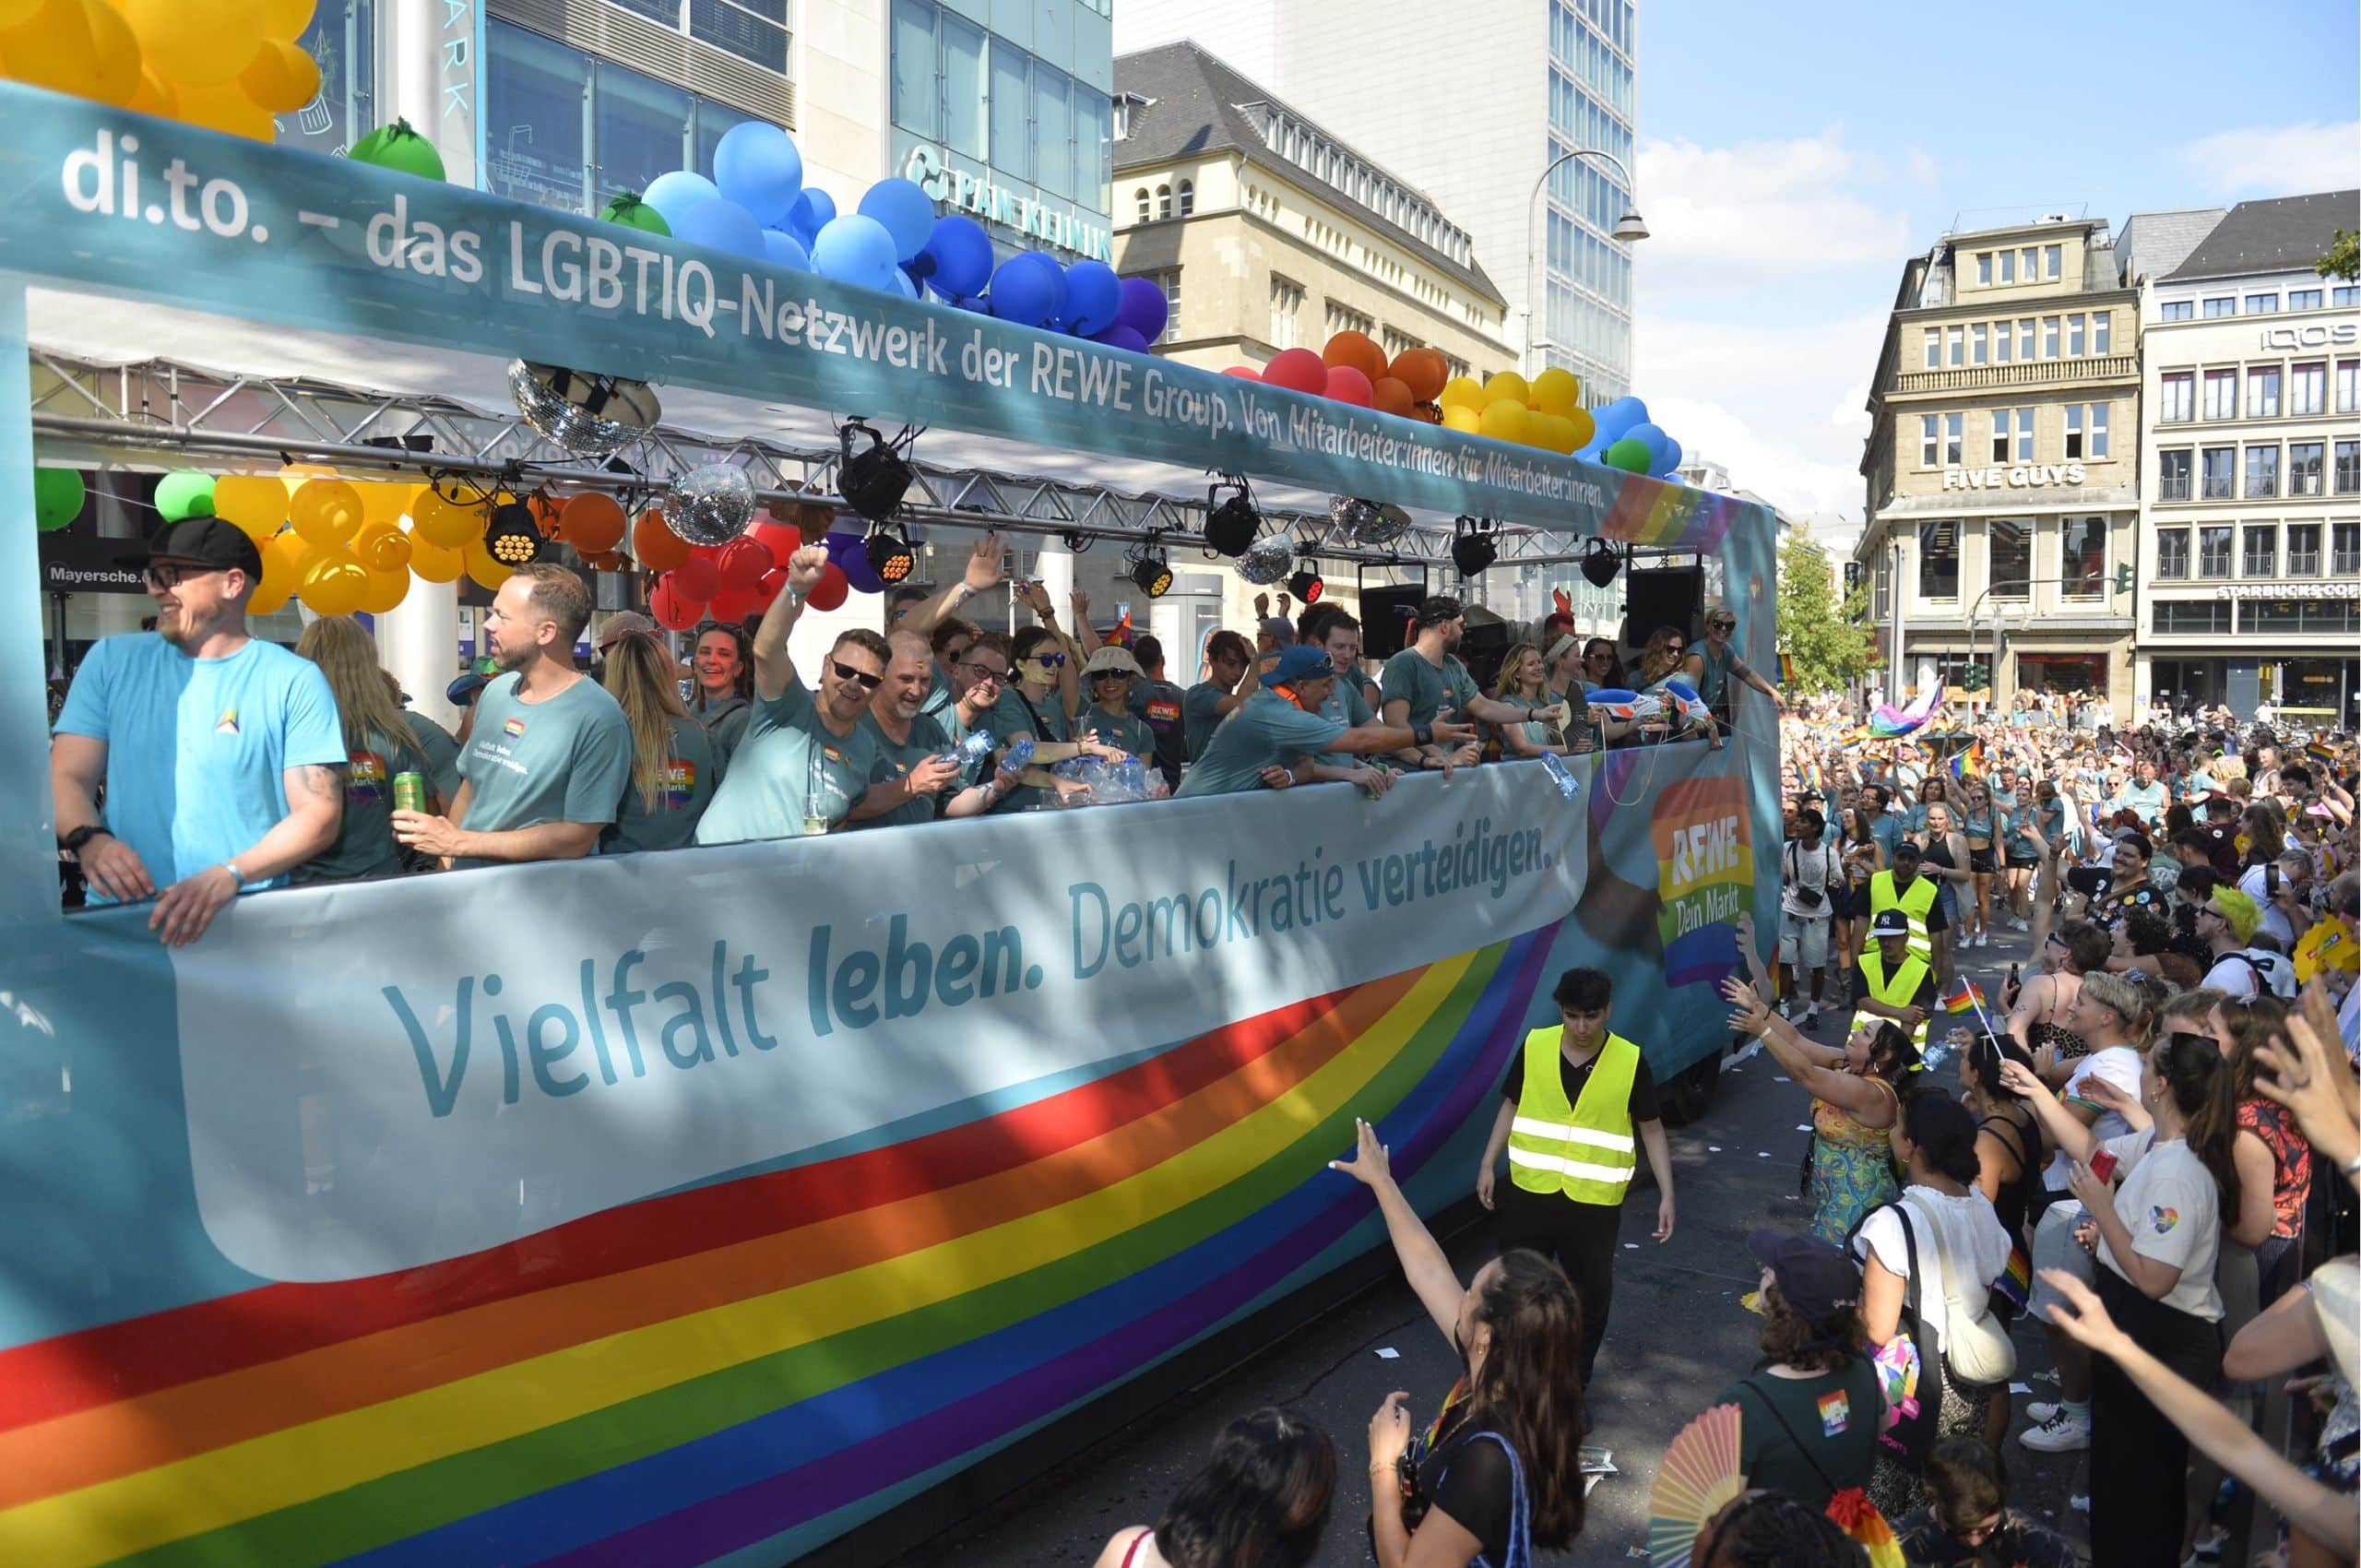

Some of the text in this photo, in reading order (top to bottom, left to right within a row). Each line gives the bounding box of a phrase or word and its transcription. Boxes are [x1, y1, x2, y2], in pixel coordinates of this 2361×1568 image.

[955, 169, 1112, 265] PAN KLINIK
[62, 128, 268, 244] di.to.
[367, 195, 483, 282] das
[510, 220, 947, 376] LGBTIQ-Netzwerk
[961, 328, 1019, 388] der
[1031, 341, 1132, 411] REWE
[1144, 369, 1233, 440] Group.
[1239, 390, 1282, 443] Von
[1288, 403, 1453, 478] Mitarbeiter:innen
[1457, 445, 1482, 483] für
[1485, 450, 1605, 508] Mitarbeiter:innen.
[2261, 324, 2358, 352] IQOS
[1943, 463, 2086, 490] FIVE GUYS
[2217, 583, 2360, 599] STARBUCKS COF
[1673, 814, 1738, 885] REWE
[1676, 883, 1739, 938] Dein Markt
[381, 816, 1553, 1118] Vielfalt leben. Demokratie verteidigen.
